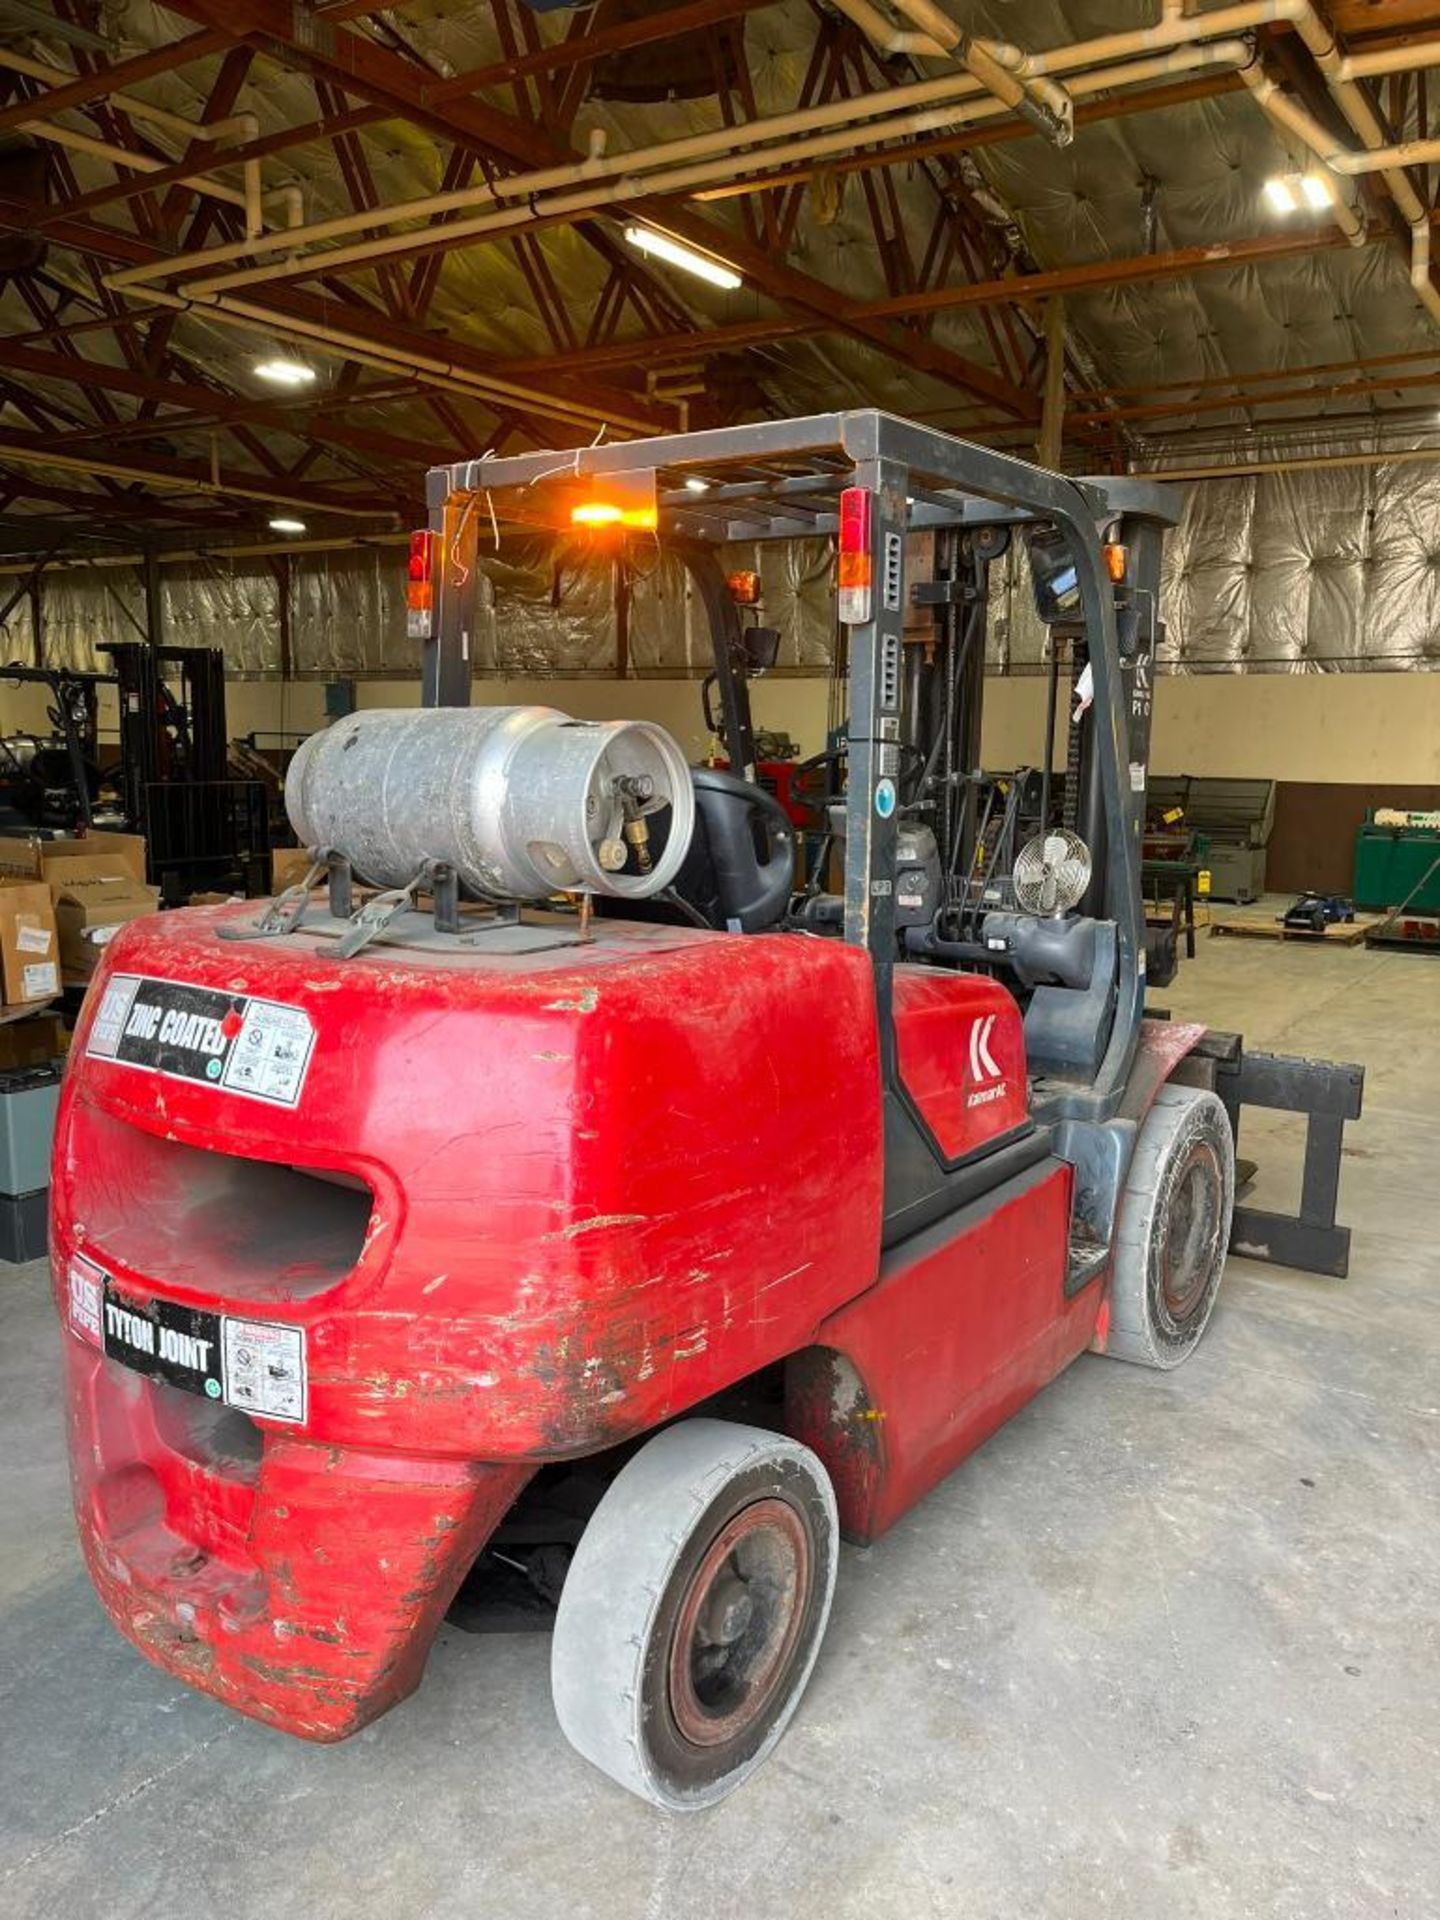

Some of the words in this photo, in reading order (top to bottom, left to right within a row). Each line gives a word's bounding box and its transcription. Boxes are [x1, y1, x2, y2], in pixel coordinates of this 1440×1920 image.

[125, 1003, 162, 1040] ZINC
[158, 1009, 227, 1056] COATED
[105, 1303, 154, 1355] TYTON
[158, 1326, 210, 1373] JOINT
